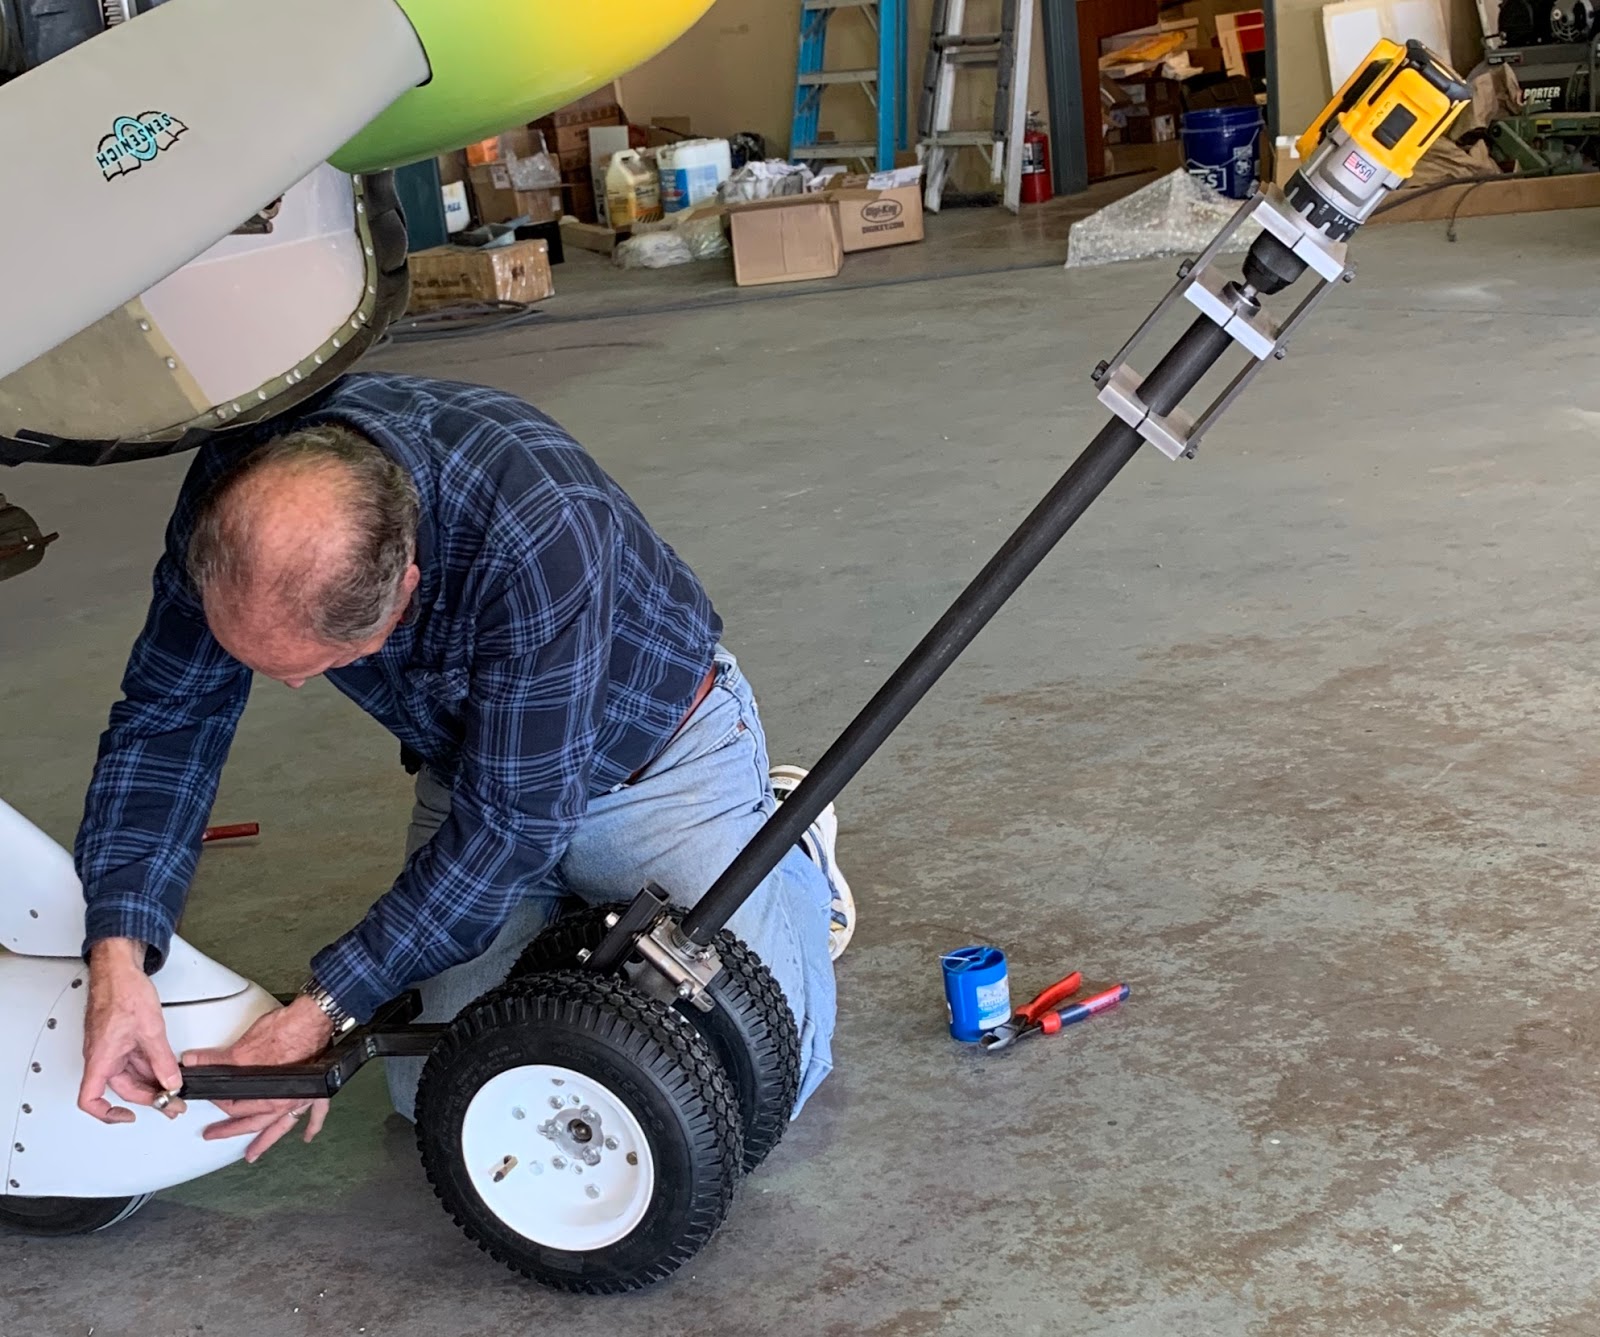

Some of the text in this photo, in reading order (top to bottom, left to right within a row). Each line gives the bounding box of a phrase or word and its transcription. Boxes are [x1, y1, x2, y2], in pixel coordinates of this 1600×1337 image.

[1523, 86, 1561, 99] PORTER
[96, 113, 172, 169] SENSENICH
[1354, 160, 1372, 178] USA
